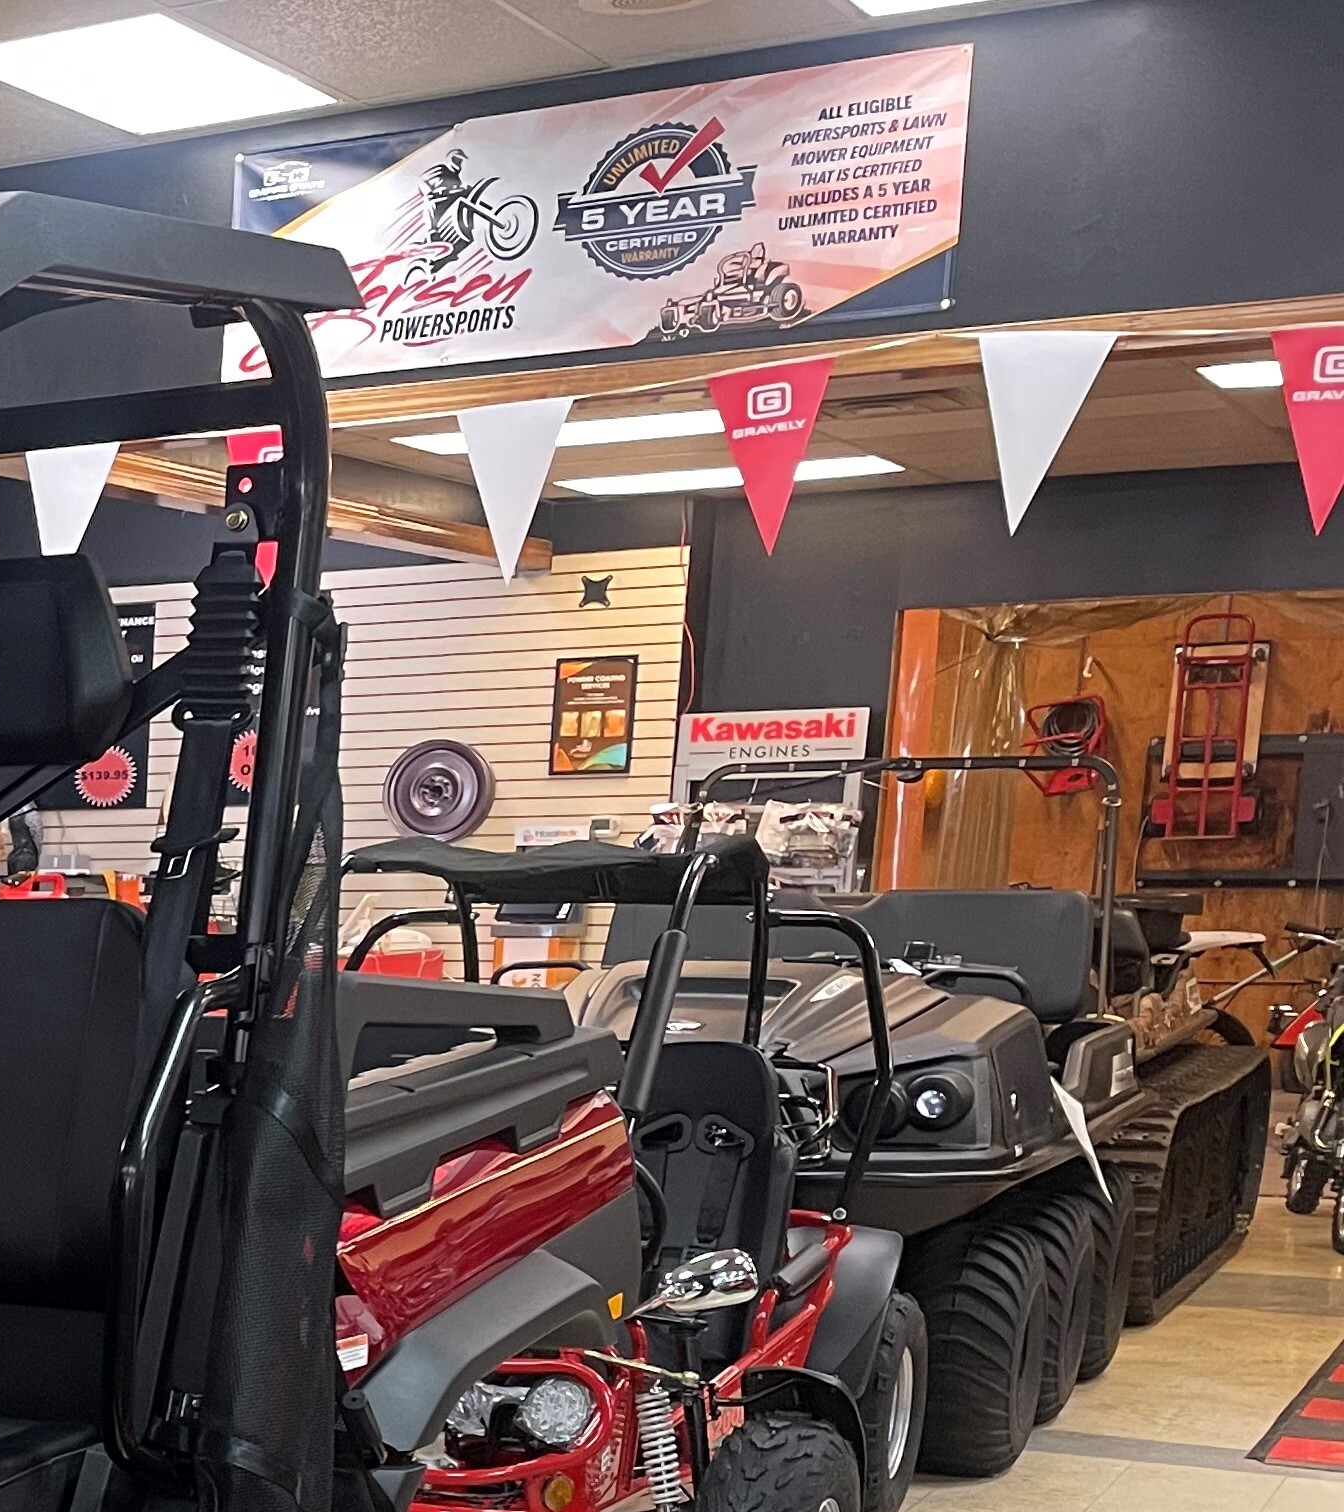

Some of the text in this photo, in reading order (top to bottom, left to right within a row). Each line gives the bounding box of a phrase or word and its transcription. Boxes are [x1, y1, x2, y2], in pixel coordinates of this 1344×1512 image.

[818, 95, 912, 121] ALL ELIGIBLE
[781, 112, 947, 147] POWERSPORTS & LAWN
[603, 139, 680, 185] UNLIMITED
[791, 135, 934, 166] MOWER EQUIPMENT
[800, 159, 923, 187] THAT IS CERTIFIED
[787, 178, 930, 209] INCLUDES A 5 YEAR
[581, 193, 726, 230] 5 YEAR
[778, 199, 938, 231] UNLIMITED CERTIFIED
[605, 231, 698, 251] CERTIFIED
[811, 224, 899, 247] WARRANTY
[621, 247, 680, 264] WARRANTY
[380, 305, 516, 342] POWERSPORTS
[1293, 390, 1344, 402] GRAV
[732, 419, 807, 439] GRAVELY
[691, 713, 856, 742] Kawasaki
[729, 745, 810, 759] ENGINES
